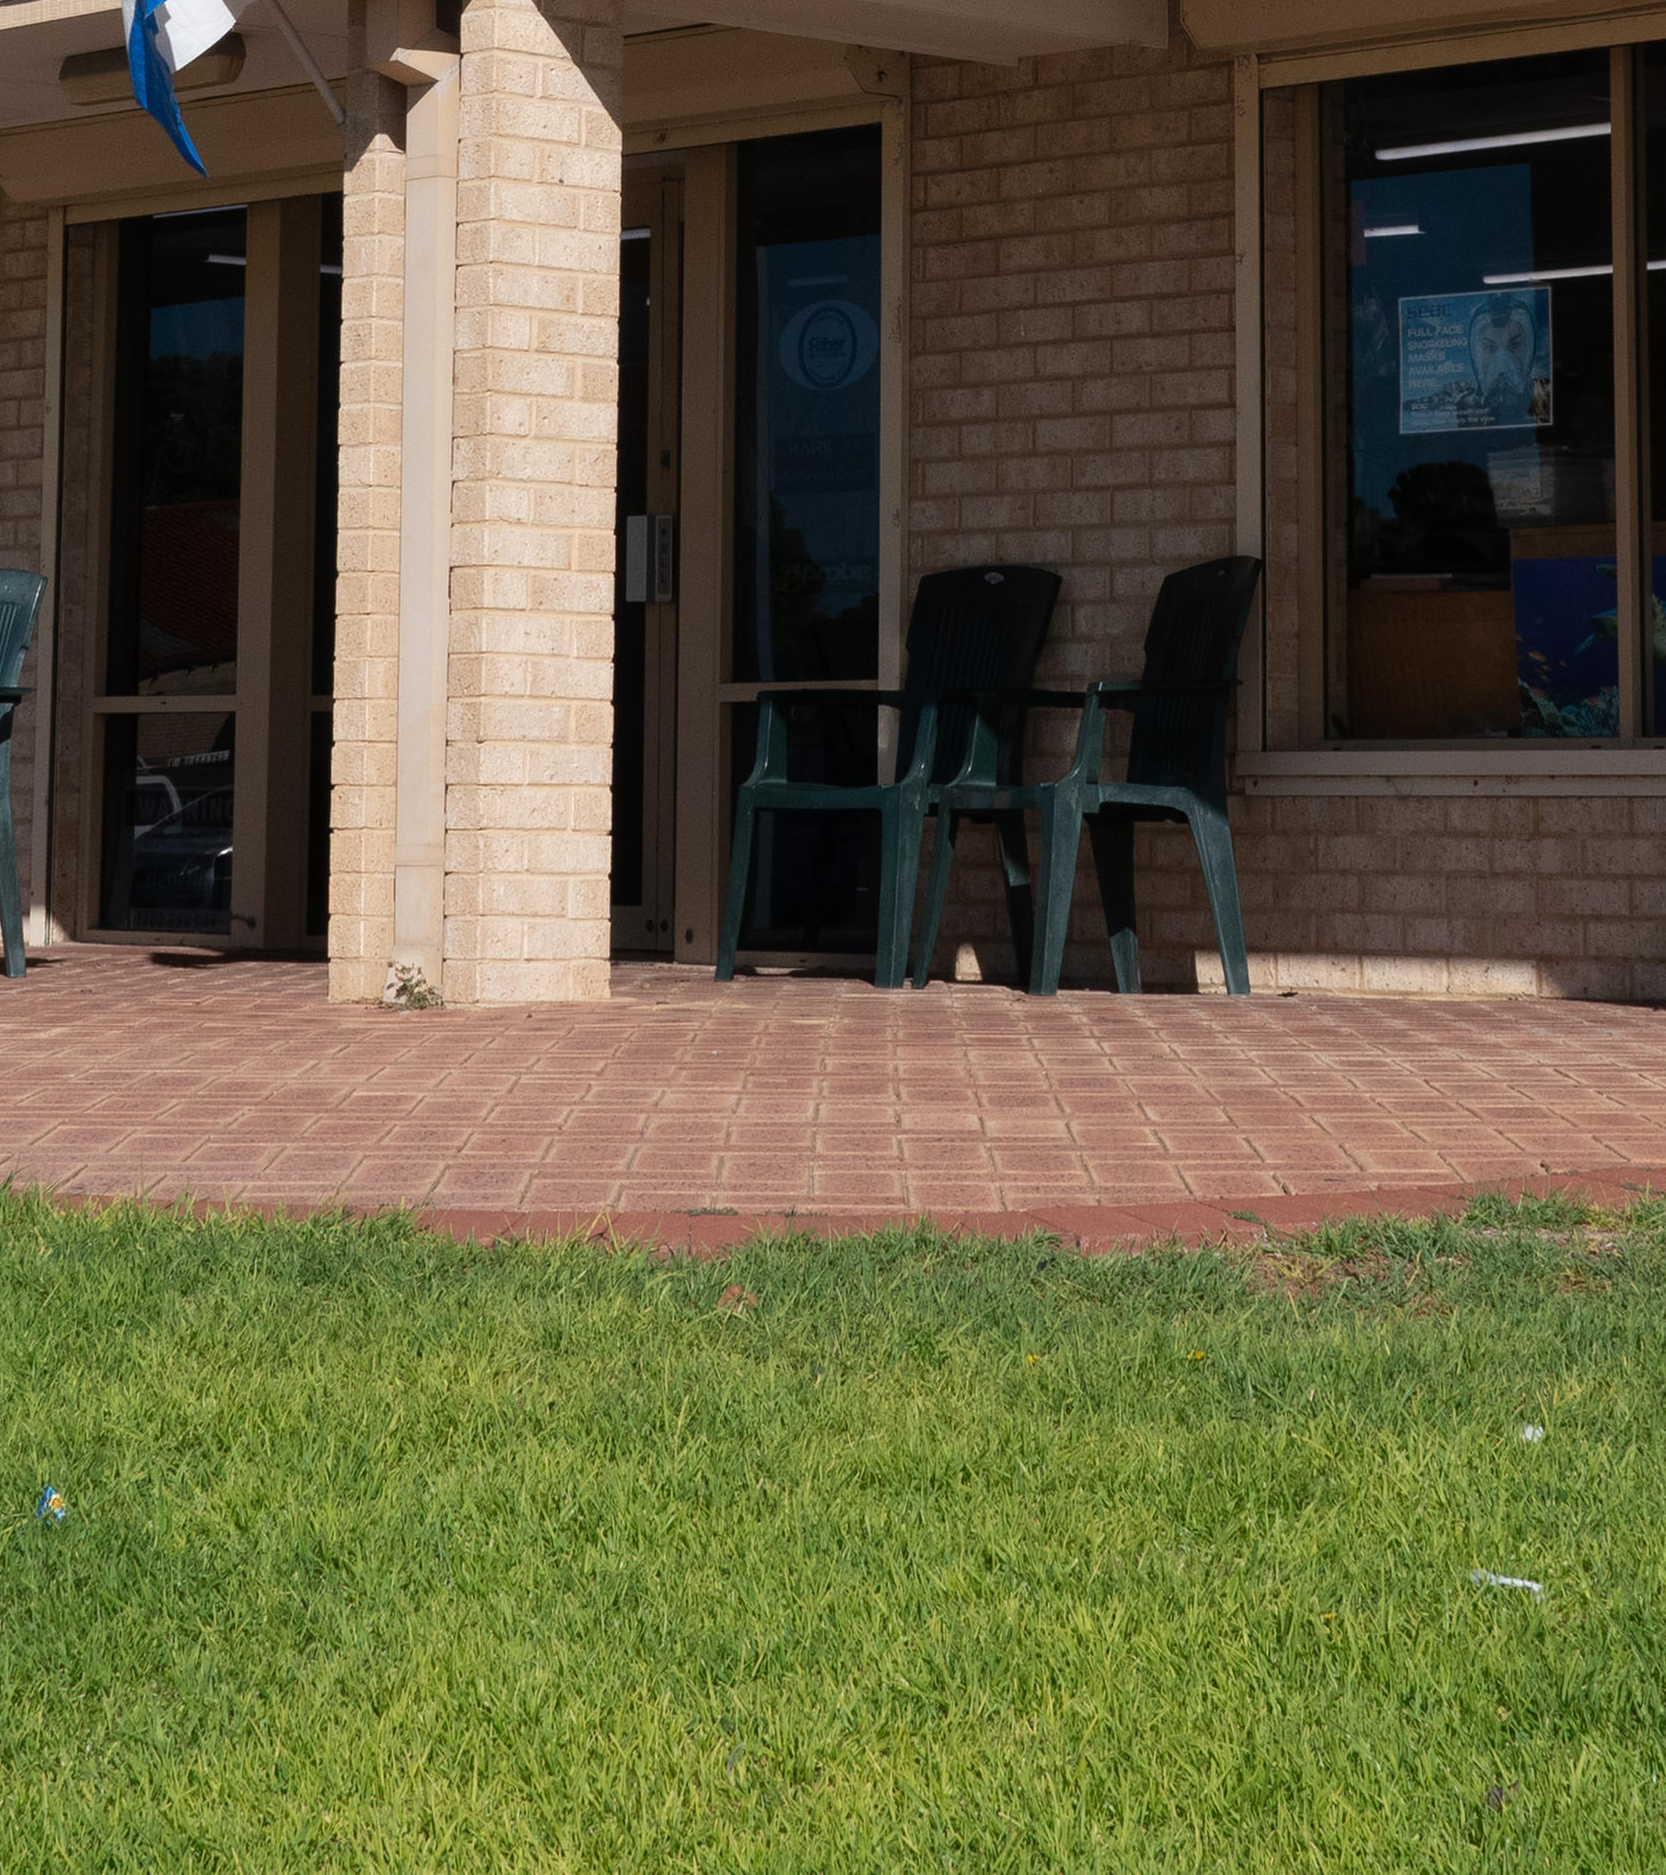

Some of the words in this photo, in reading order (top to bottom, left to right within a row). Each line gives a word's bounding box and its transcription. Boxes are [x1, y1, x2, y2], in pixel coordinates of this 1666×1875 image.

[1407, 327, 1432, 338] FULL
[1436, 323, 1463, 336] FACE
[1407, 337, 1469, 351] SNORKELING
[1407, 350, 1446, 363] MASKS
[1408, 362, 1465, 376] AVAILABLE
